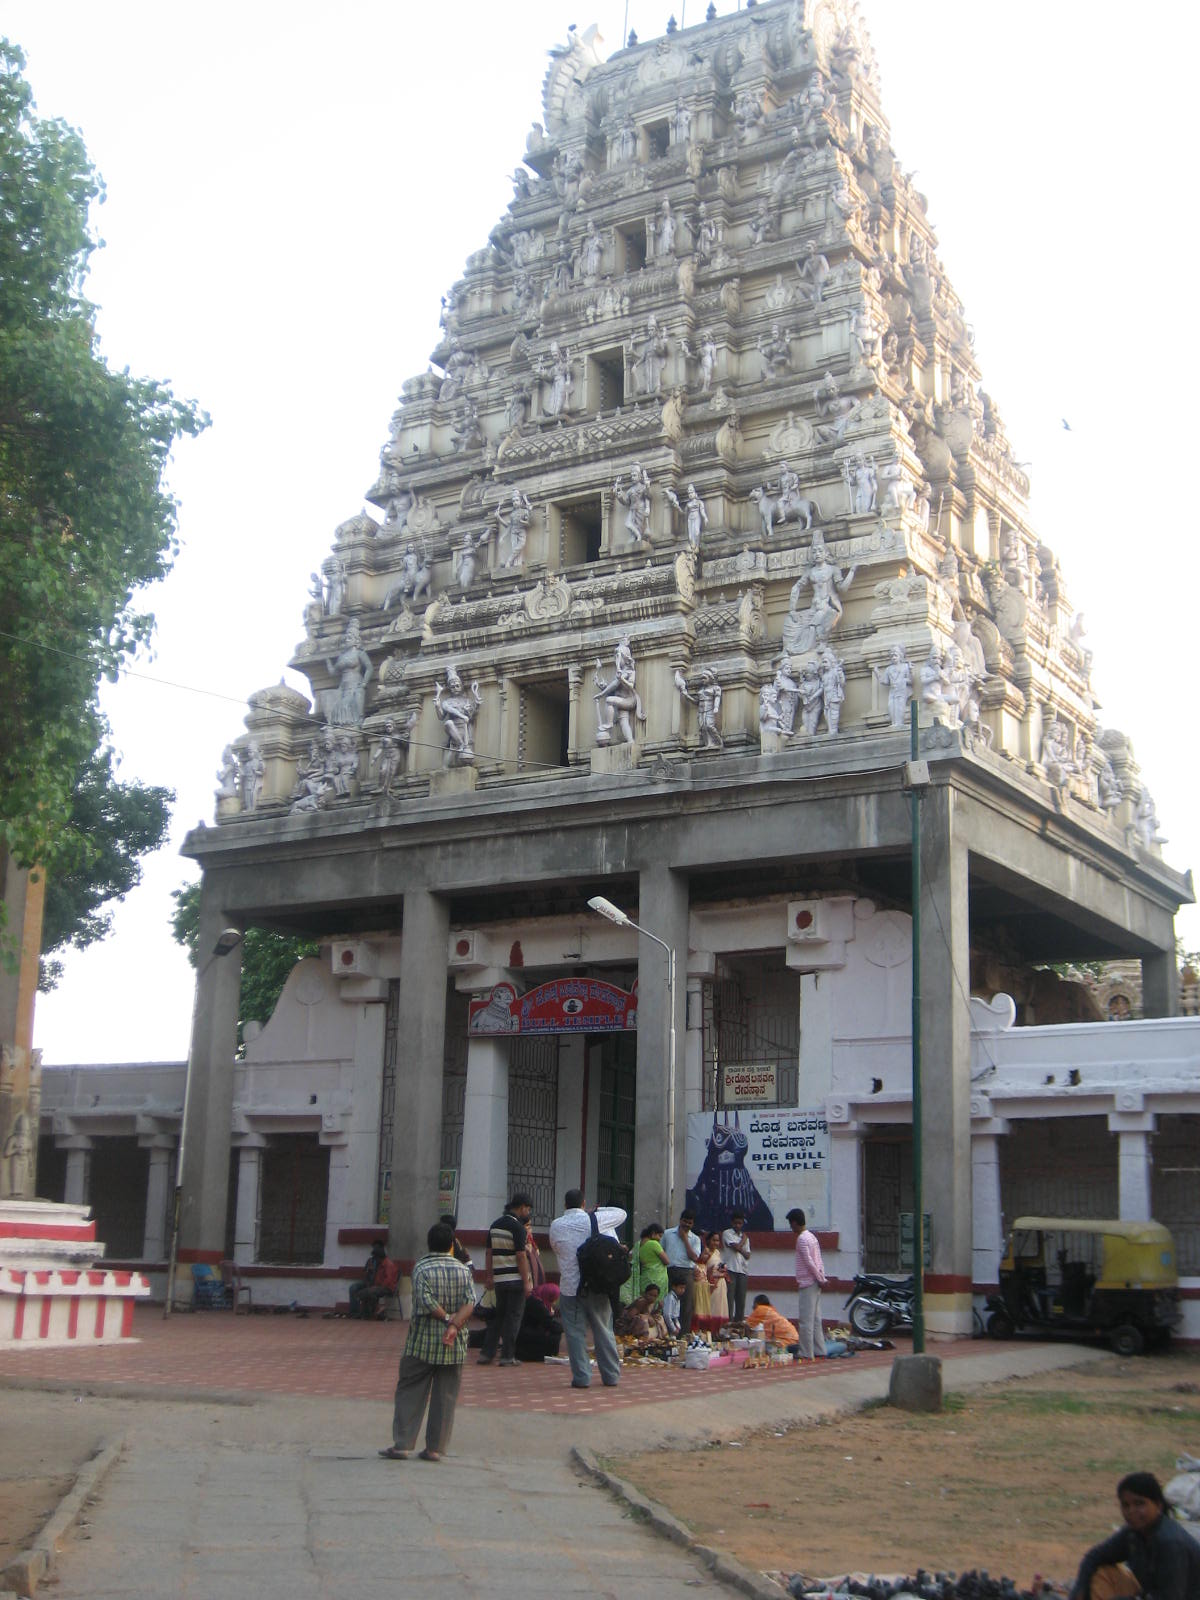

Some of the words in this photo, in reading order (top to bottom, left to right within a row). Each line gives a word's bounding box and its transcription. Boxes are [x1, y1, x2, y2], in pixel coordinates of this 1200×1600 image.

[521, 1017, 560, 1027] BULL
[563, 1015, 624, 1026] TEMPLE
[752, 1153, 779, 1161] BIG
[785, 1151, 826, 1160] BULL
[756, 1161, 822, 1171] TEMPLE
